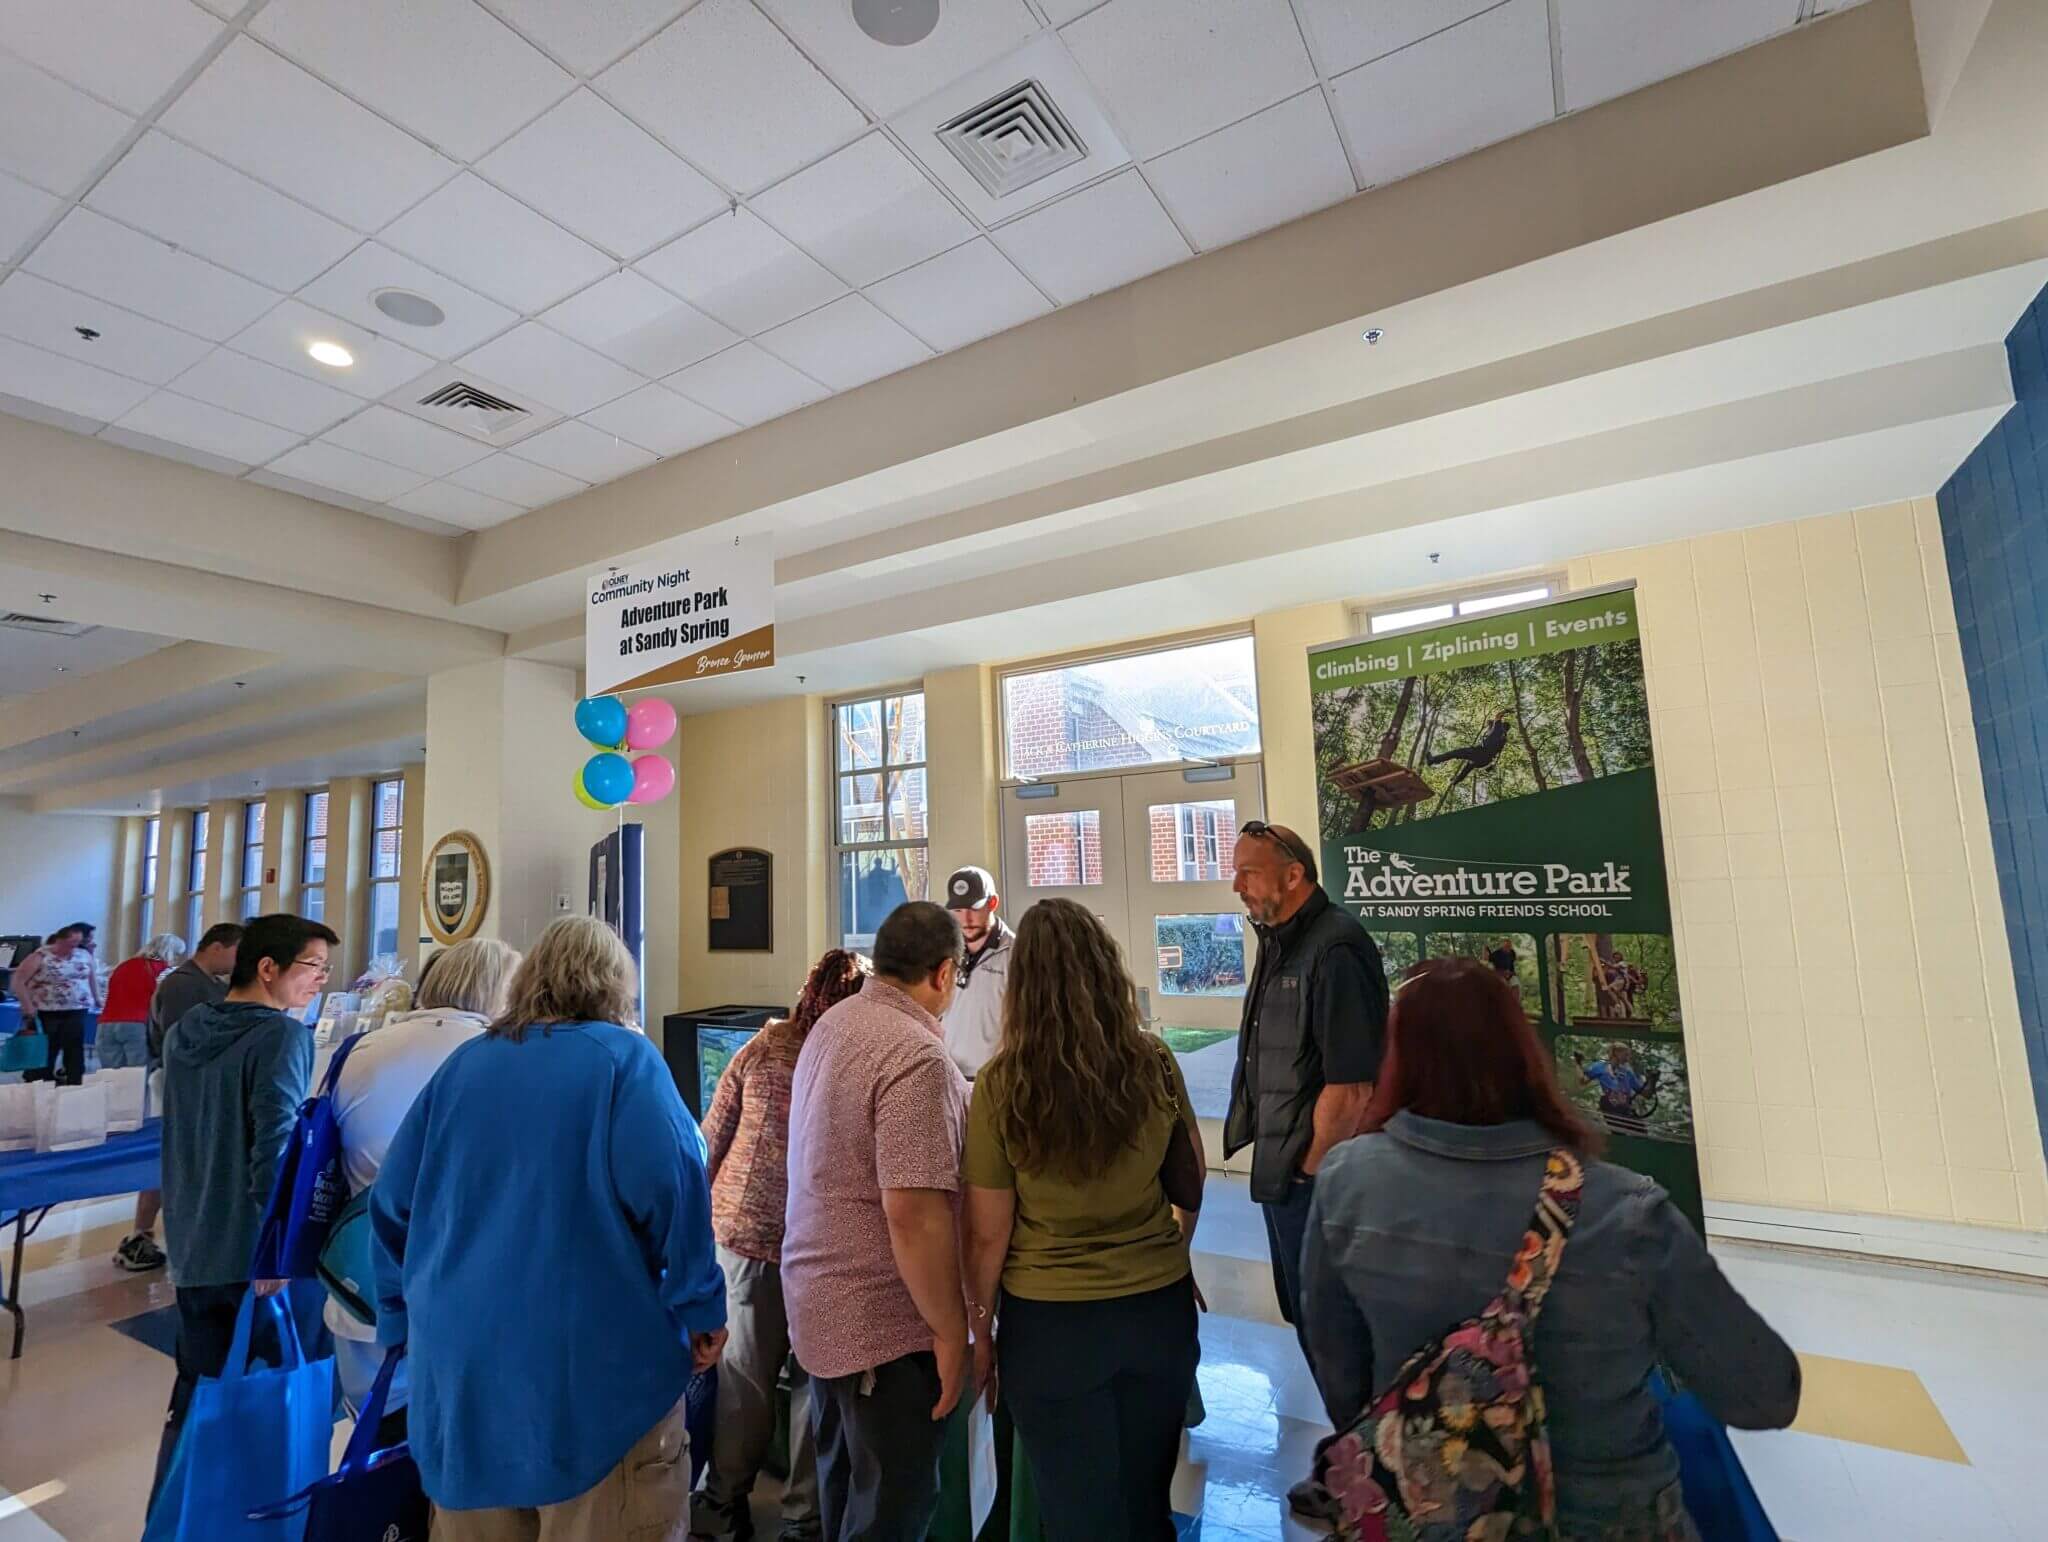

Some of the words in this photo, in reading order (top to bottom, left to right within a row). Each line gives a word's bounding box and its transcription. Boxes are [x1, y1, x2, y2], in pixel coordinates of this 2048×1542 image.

[592, 579, 654, 604] Community
[657, 569, 690, 588] Night
[621, 598, 690, 628] Adventure
[694, 587, 728, 612] Park
[620, 638, 633, 655] at
[636, 625, 677, 652] Sandy
[681, 618, 729, 648] Spring
[1316, 654, 1399, 680] Climbing
[1421, 632, 1519, 662] Ziplining
[1546, 610, 1628, 638] Events
[1175, 721, 1249, 738] COURTYARD
[1344, 846, 1381, 864] The
[1344, 866, 1538, 897] Adventure
[1544, 862, 1631, 894] Park
[1360, 906, 1375, 917] AT
[1378, 906, 1420, 917] SANDY
[1423, 905, 1475, 917] SPRING
[1479, 905, 1545, 917] FRIENDS
[1549, 904, 1613, 917] SCHOOL
